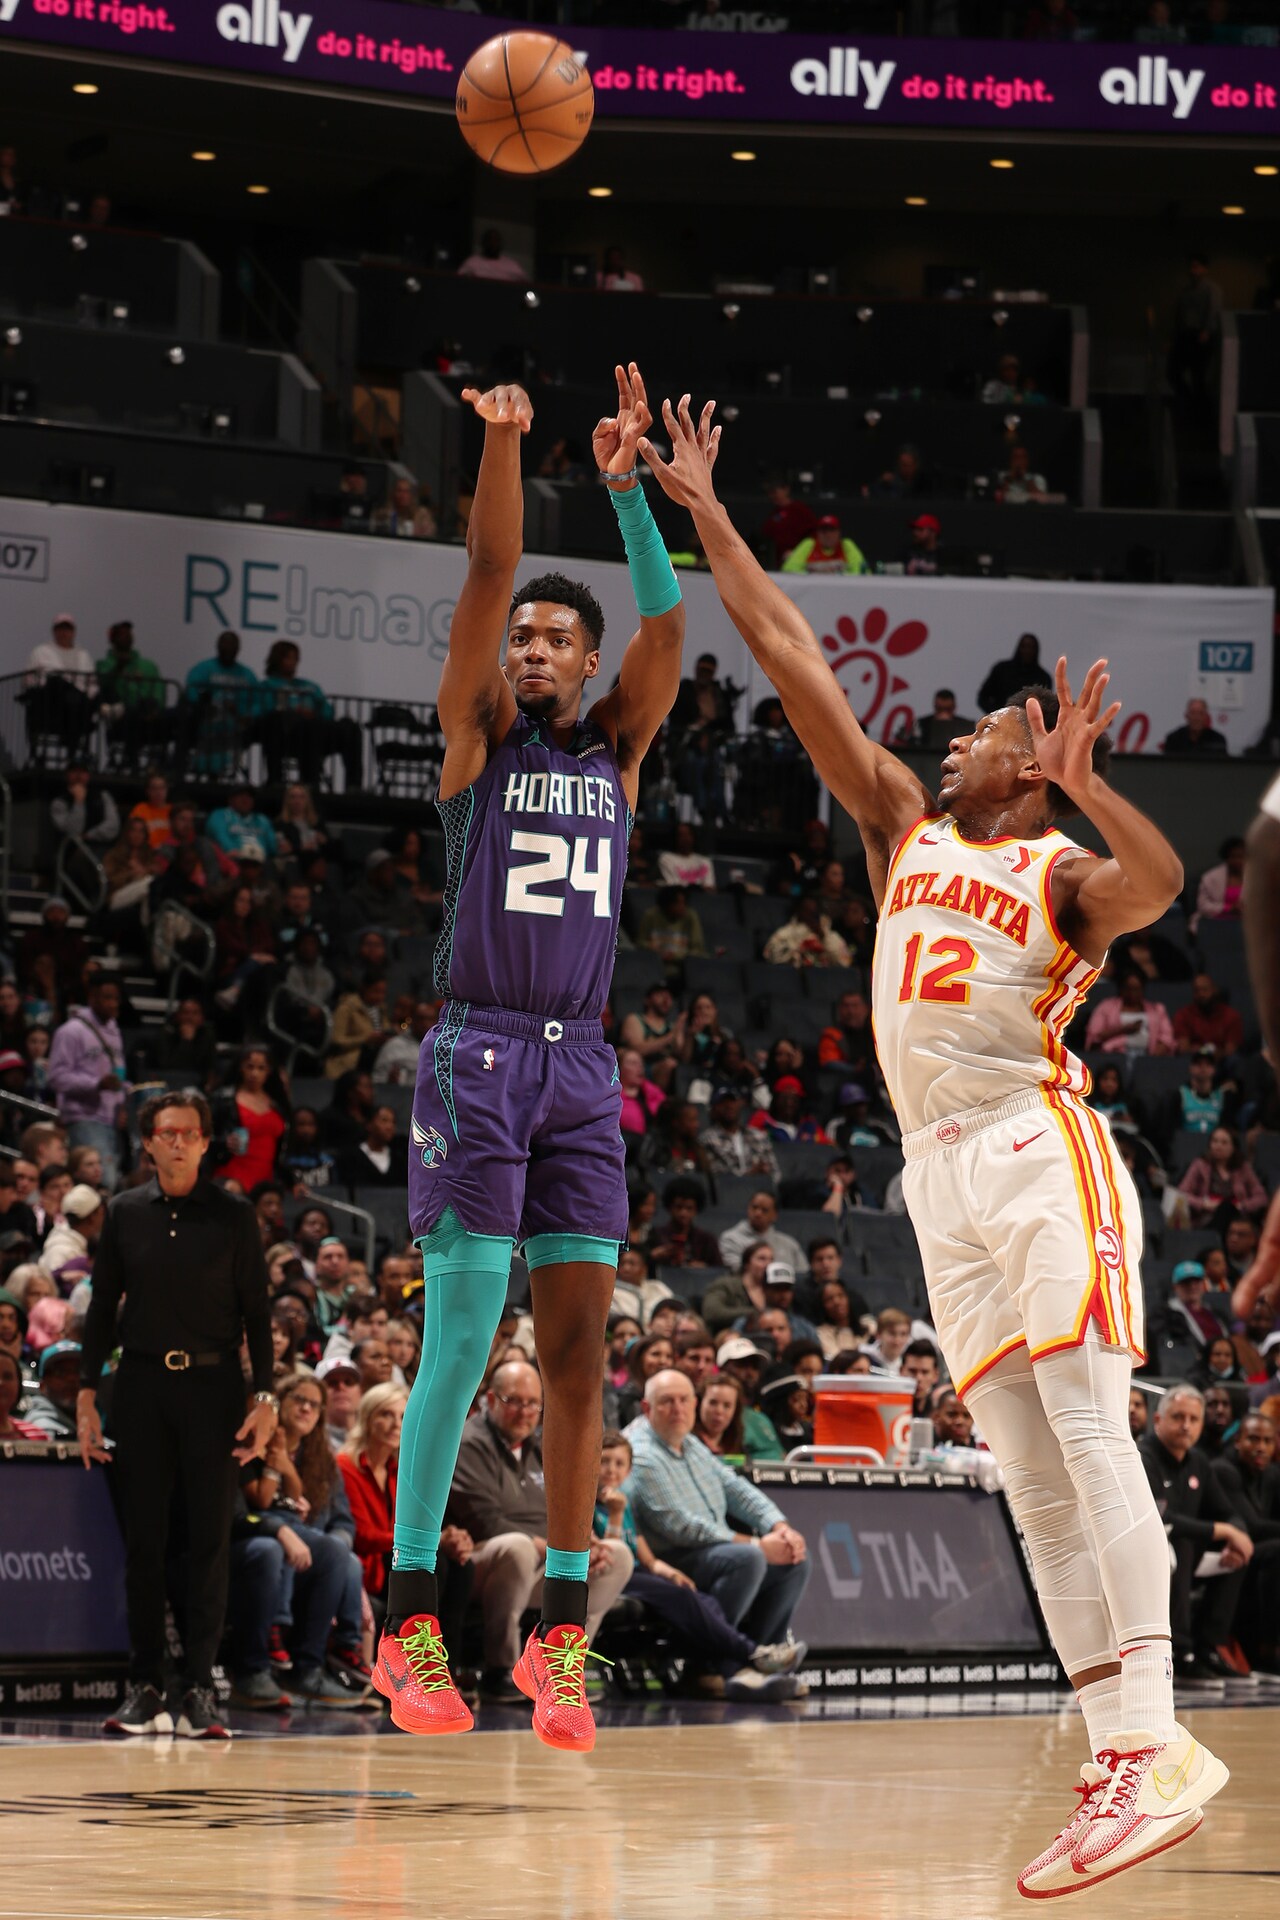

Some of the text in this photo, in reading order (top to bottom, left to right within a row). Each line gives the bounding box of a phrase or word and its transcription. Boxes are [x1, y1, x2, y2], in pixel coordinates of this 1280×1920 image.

[99, 0, 176, 34] right.
[216, 0, 453, 74] ally do it right.
[593, 65, 632, 90] do
[636, 65, 659, 91] it
[662, 66, 746, 100] right.
[790, 47, 1055, 110] ally do it right.
[1099, 55, 1277, 119] ally do it
[0, 543, 38, 570] 07
[1206, 645, 1248, 668] 107
[500, 771, 616, 824] HORNETS
[503, 829, 612, 918] 24
[887, 872, 1031, 949] ATLANTA
[897, 931, 979, 1006] 12
[936, 1123, 962, 1141] HAWKS
[858, 1531, 971, 1600] TIAA
